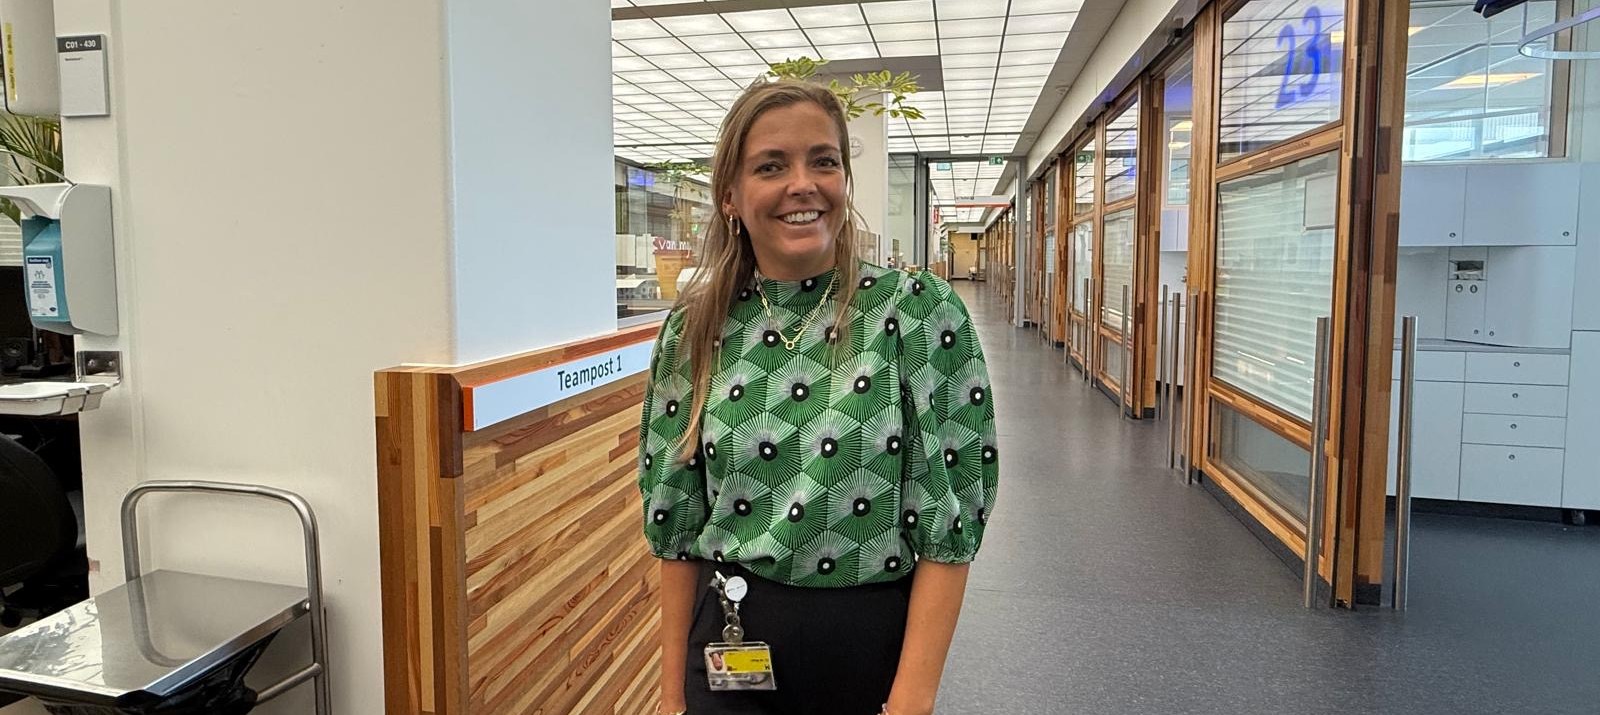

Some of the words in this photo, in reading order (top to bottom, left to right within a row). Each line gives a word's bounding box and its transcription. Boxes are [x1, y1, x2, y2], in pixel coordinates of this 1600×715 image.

[65, 41, 78, 49] C01
[84, 39, 96, 48] 430
[1275, 6, 1322, 109] 23
[557, 357, 614, 391] Teampost
[616, 354, 622, 372] 1
